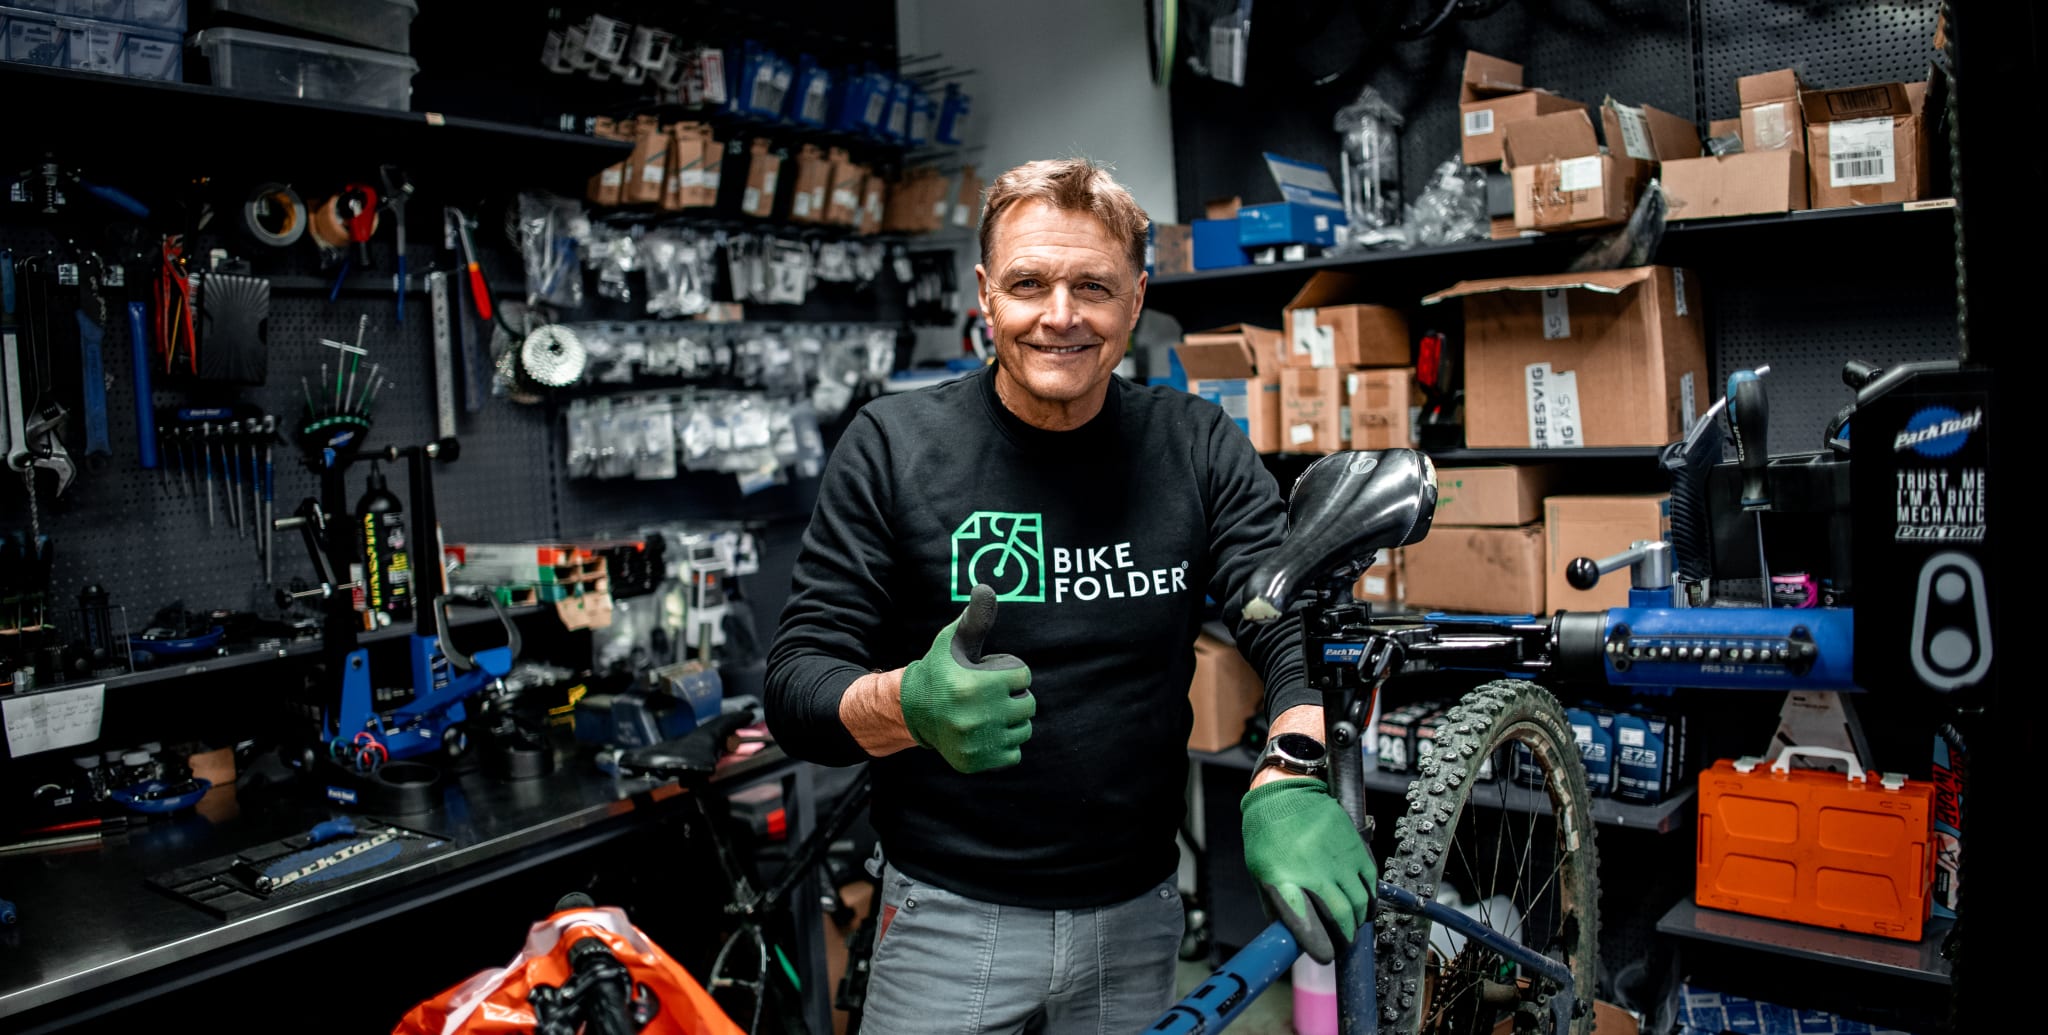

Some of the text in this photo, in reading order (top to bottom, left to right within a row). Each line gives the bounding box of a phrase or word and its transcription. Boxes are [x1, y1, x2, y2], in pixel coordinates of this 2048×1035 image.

[1897, 471, 1985, 491] TRUST ME
[1897, 489, 1985, 506] I'M A BIKE
[1897, 506, 1985, 522] MECHANIC
[1053, 542, 1134, 573] BIKE
